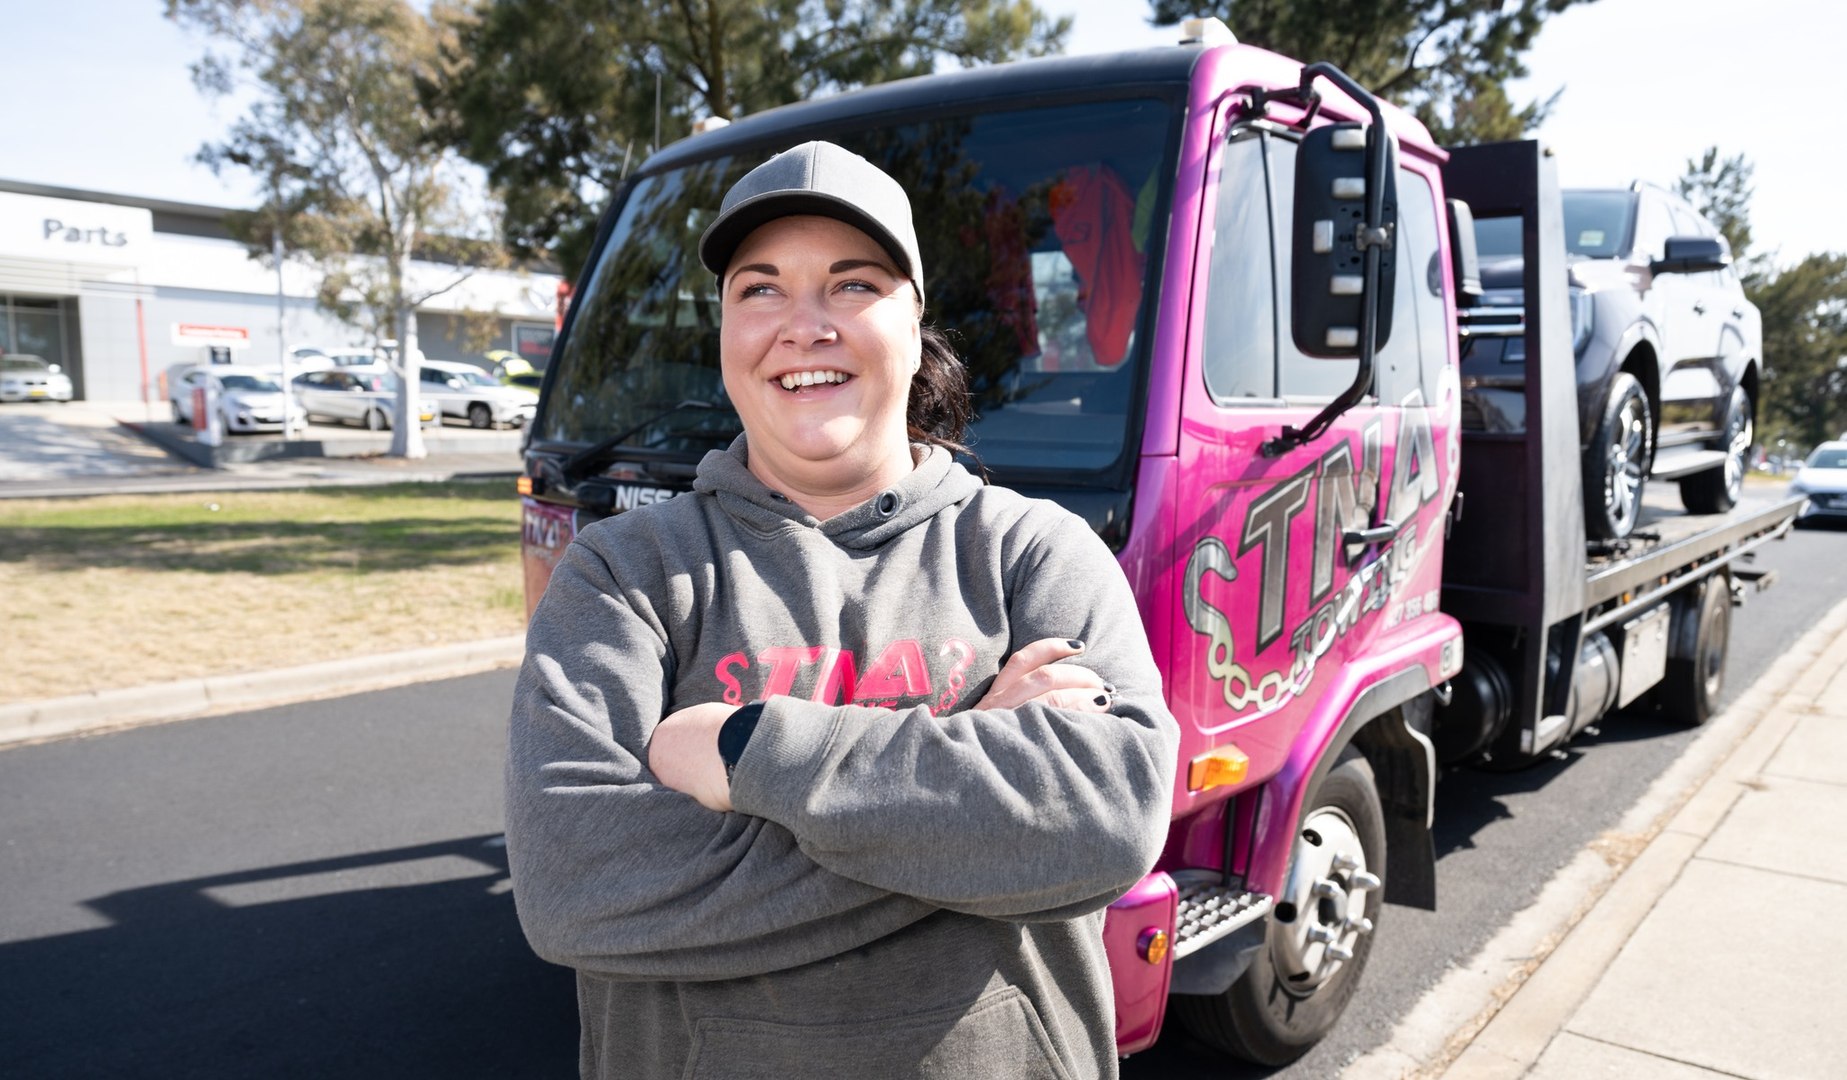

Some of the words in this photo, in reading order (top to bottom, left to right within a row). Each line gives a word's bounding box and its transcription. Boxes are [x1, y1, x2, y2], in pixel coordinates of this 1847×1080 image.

[43, 218, 128, 247] Parts
[615, 485, 685, 509] NISS
[1236, 387, 1440, 657] TNA
